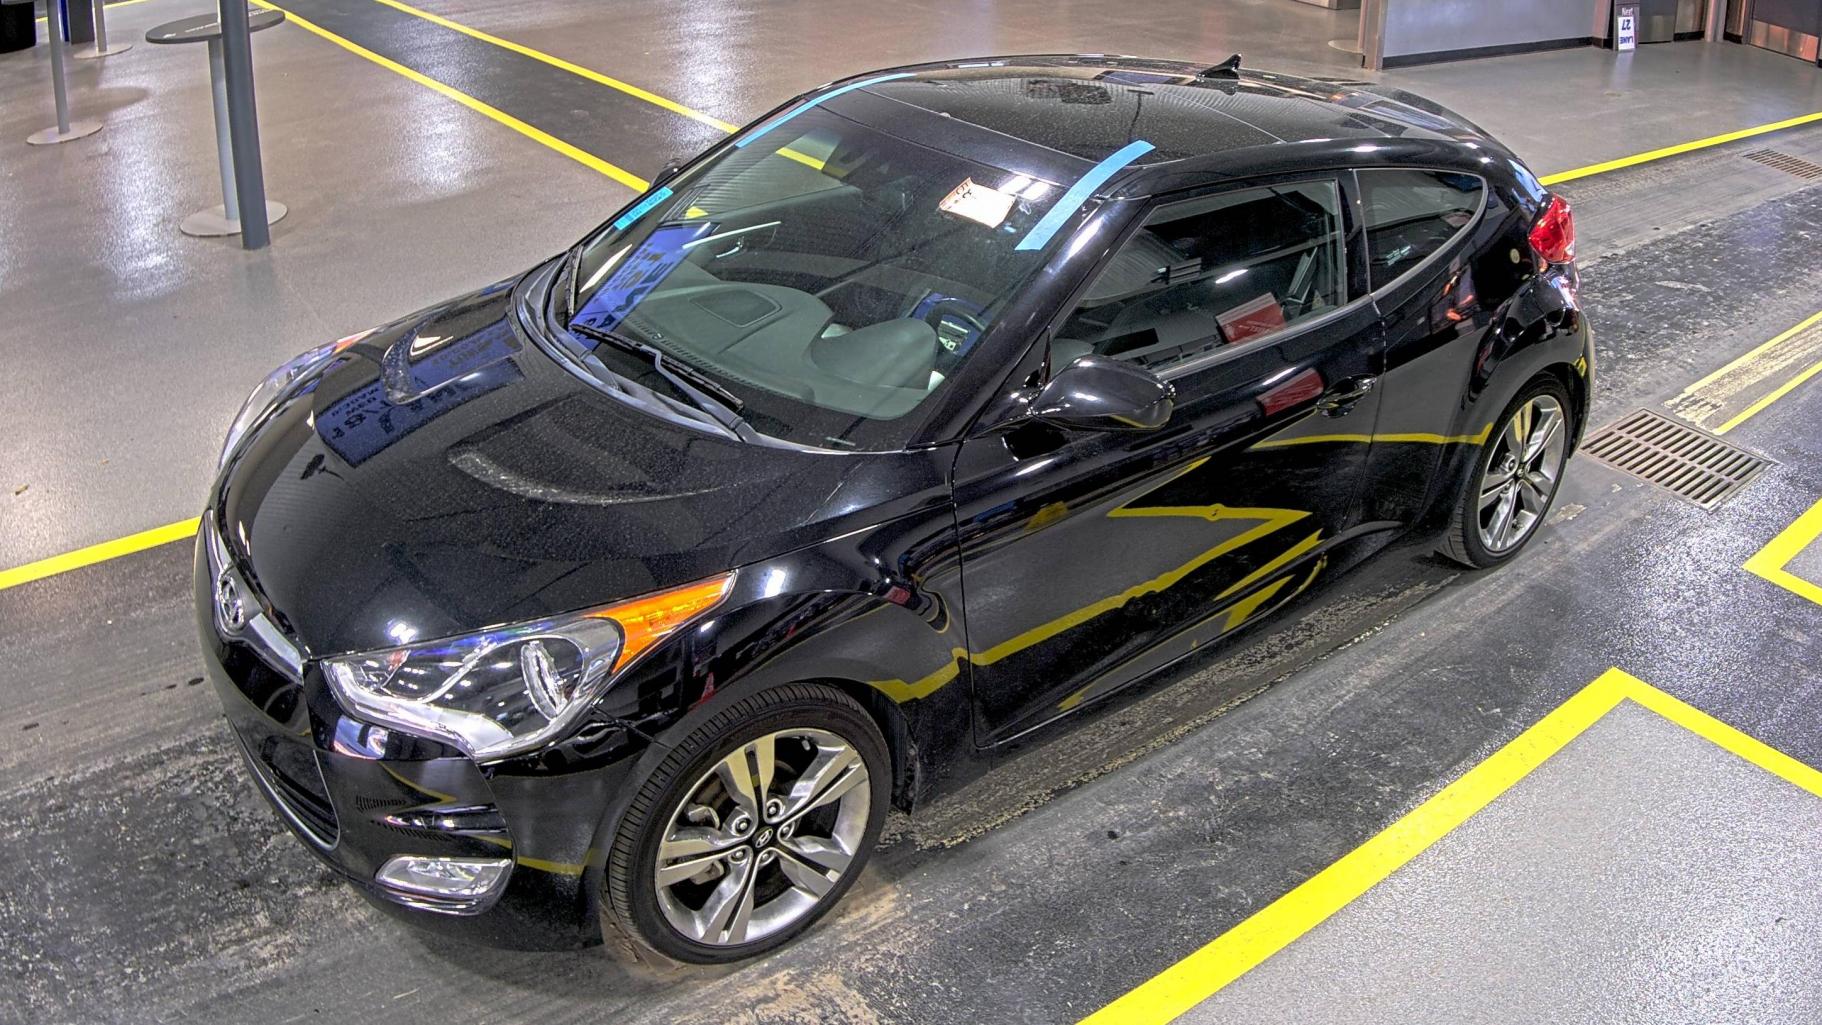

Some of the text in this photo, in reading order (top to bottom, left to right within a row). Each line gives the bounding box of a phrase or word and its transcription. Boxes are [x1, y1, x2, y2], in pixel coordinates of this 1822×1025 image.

[1622, 7, 1633, 16] Next
[1622, 19, 1631, 30] 27
[1619, 36, 1633, 44] LANE
